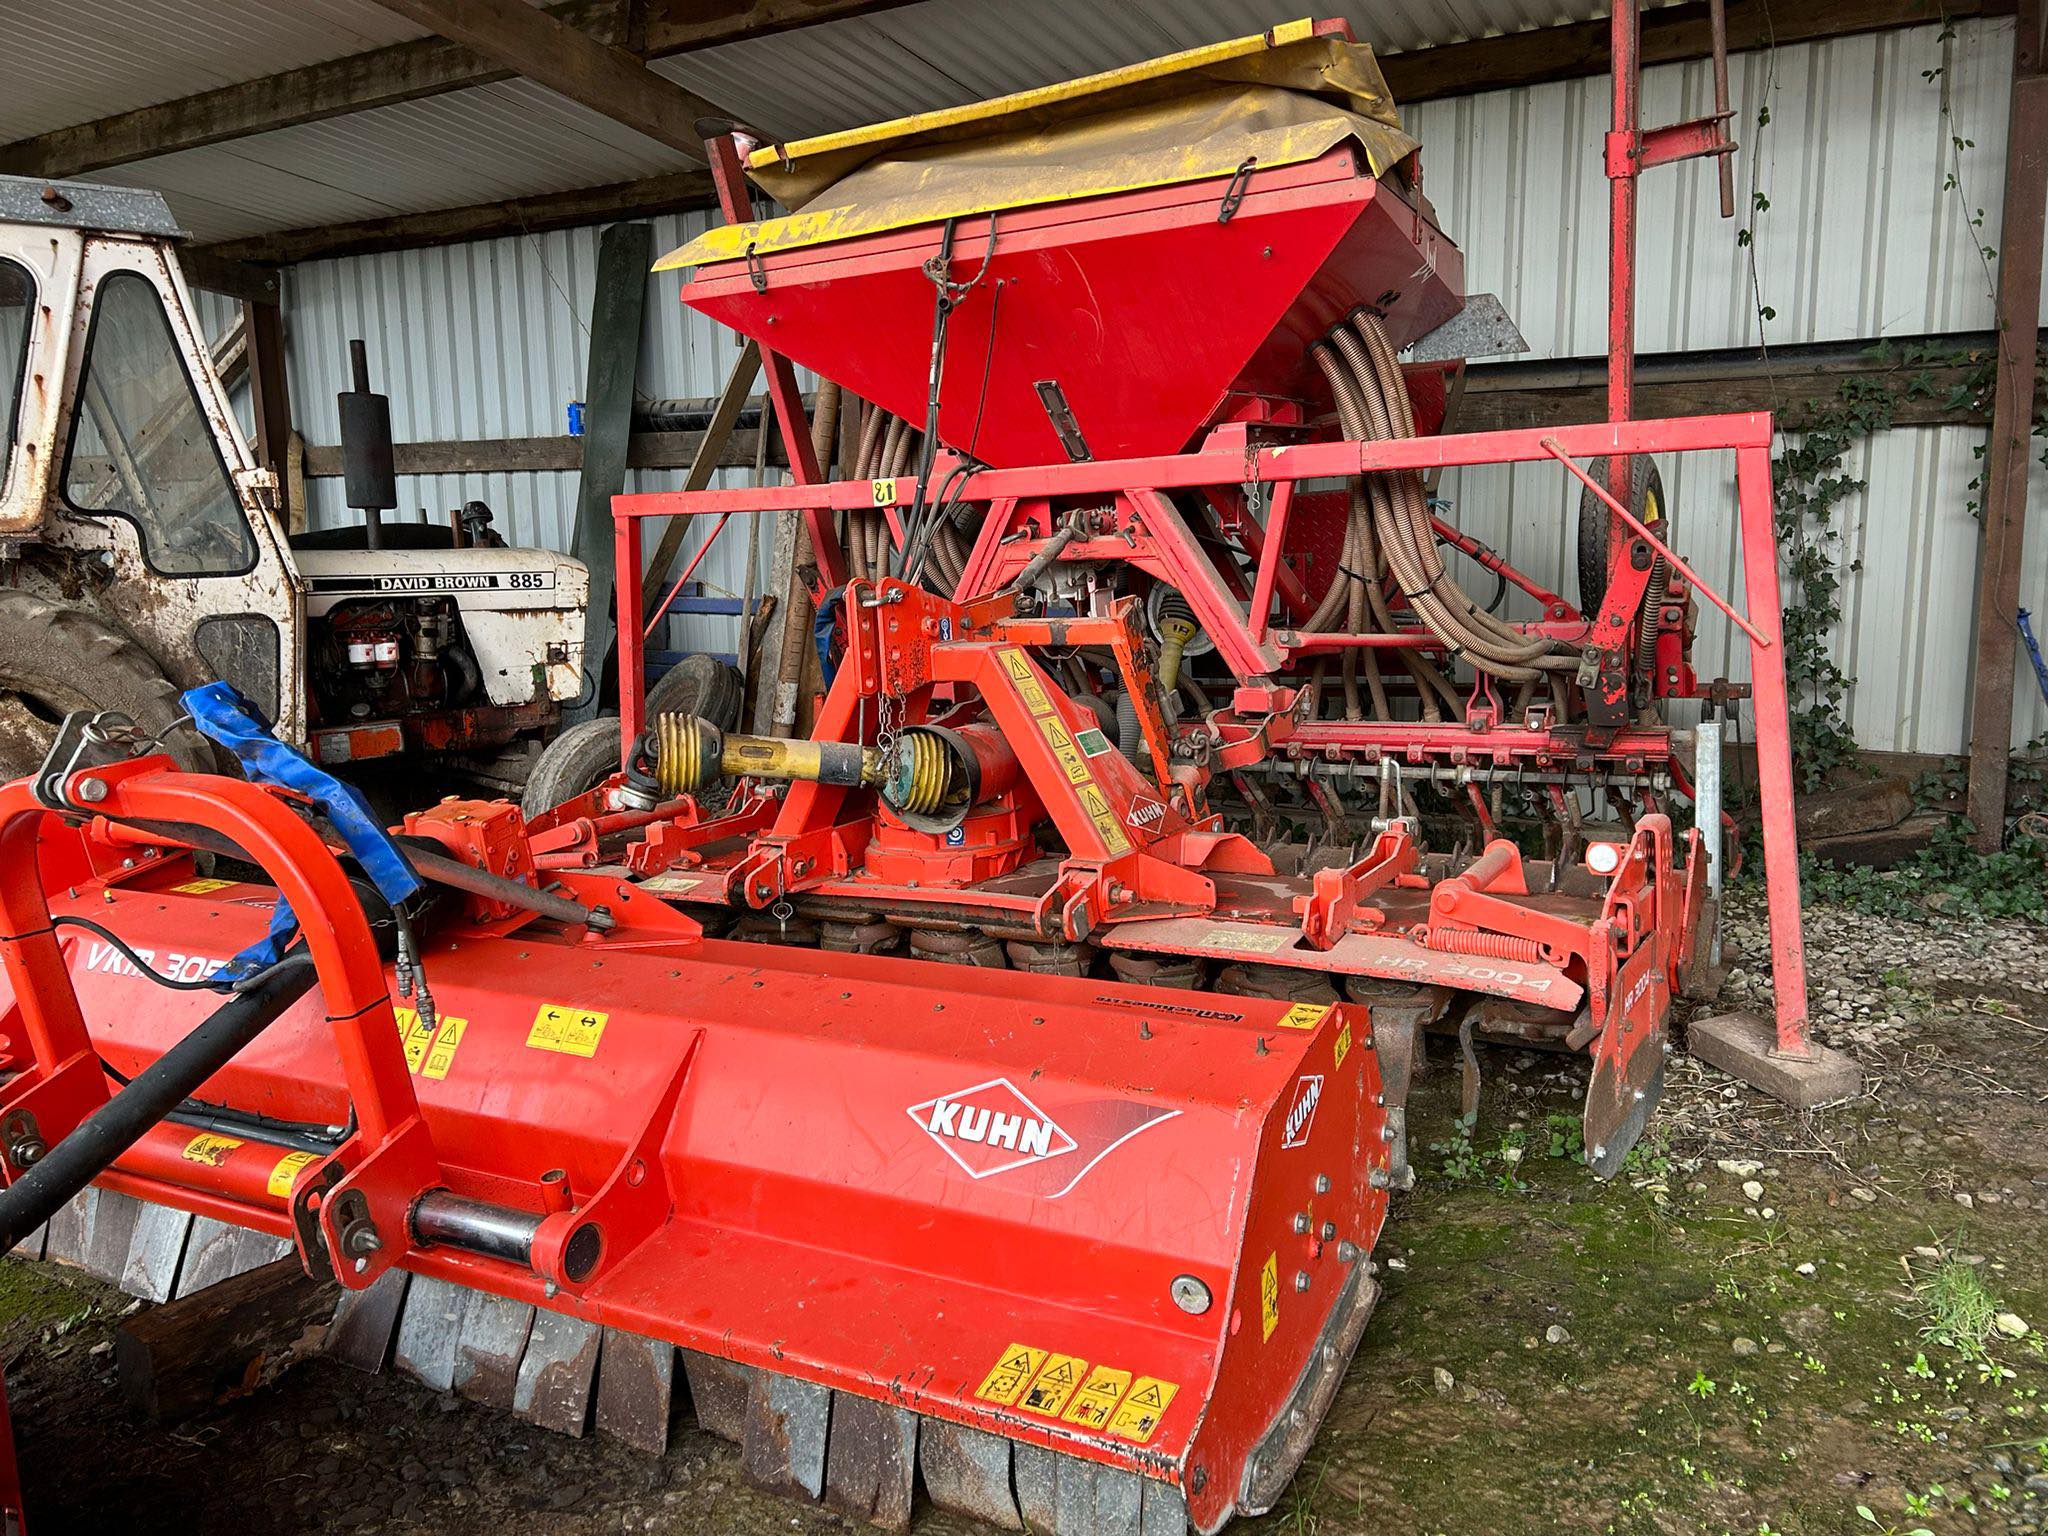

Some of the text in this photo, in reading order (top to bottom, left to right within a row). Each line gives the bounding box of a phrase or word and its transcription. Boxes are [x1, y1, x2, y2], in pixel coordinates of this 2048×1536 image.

[380, 573, 543, 590] DAVID BROWN 885
[1130, 802, 1164, 826] KUHN
[1374, 955, 1553, 993] HR 3004
[928, 1099, 1055, 1157] KUHN
[1285, 1075, 1320, 1146] KUHN
